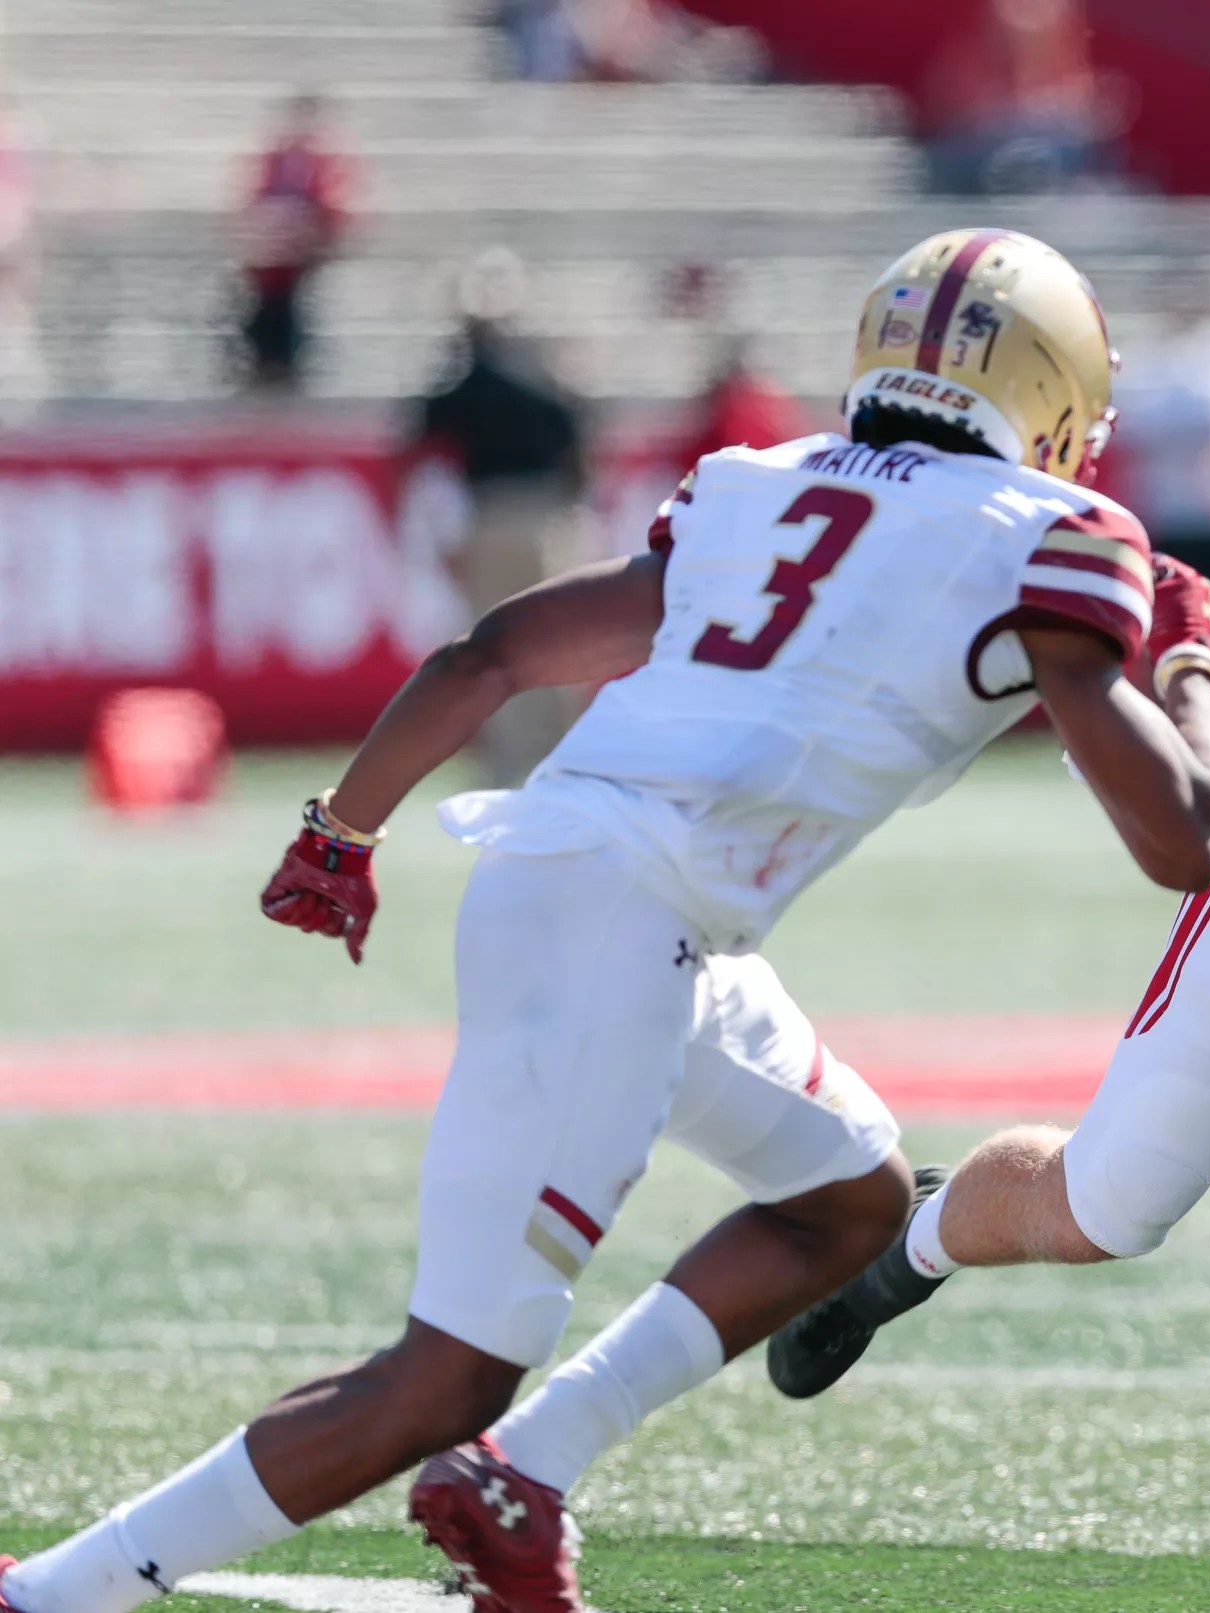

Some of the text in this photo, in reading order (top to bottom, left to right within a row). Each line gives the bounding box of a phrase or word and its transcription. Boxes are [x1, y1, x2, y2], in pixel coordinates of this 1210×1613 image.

[874, 372, 977, 412] EAGLES
[799, 446, 927, 482] MAITRE
[690, 484, 874, 671] 3
